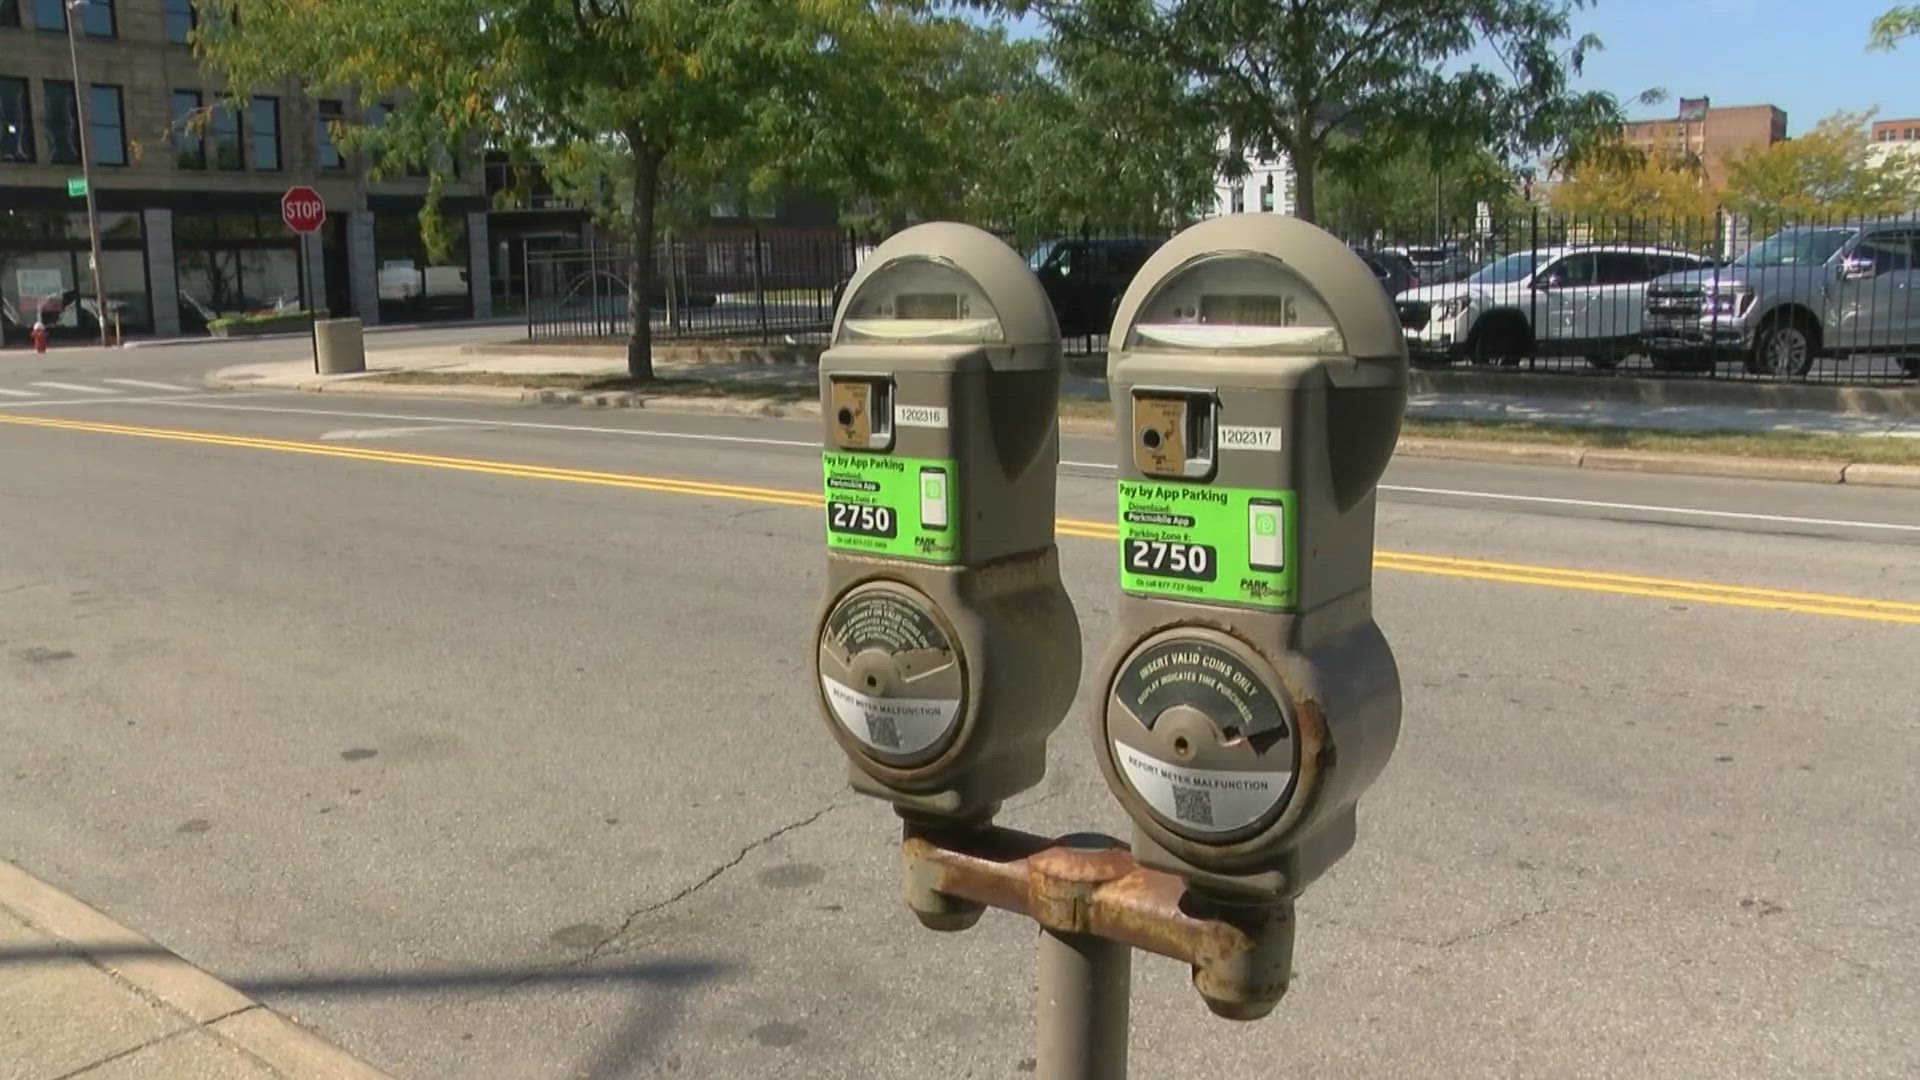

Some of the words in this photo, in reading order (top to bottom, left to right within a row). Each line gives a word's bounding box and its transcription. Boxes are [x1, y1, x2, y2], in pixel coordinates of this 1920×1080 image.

[285, 199, 322, 221] STOP
[1221, 430, 1272, 444] 1202317
[838, 455, 850, 468] by
[850, 457, 868, 470] App
[869, 458, 905, 473] Parking
[1119, 483, 1136, 497] Pay
[1138, 484, 1155, 499] by
[1156, 486, 1180, 501] App
[1182, 489, 1228, 505] Parking
[833, 502, 890, 532] 2750
[1127, 512, 1171, 525] Parkmobile
[1172, 516, 1190, 527] App
[1129, 528, 1160, 541] Parking
[1160, 531, 1180, 541] Zone
[1132, 541, 1207, 574] 2750
[1240, 577, 1269, 591] PARK
[1138, 653, 1170, 681] INSERT
[1171, 651, 1200, 665] VALID
[1201, 654, 1233, 677] COINS
[1232, 670, 1259, 698] ONLY
[1137, 680, 1160, 705] DISPLAY
[1161, 671, 1196, 686] INDICATES
[1197, 671, 1216, 688] TIME
[1216, 682, 1254, 724] PURCHASED
[878, 703, 942, 717] MALFUNCTION
[1128, 755, 1159, 777] REPORT
[1159, 767, 1191, 785] METER
[1191, 776, 1269, 792] MALFUNCTION
